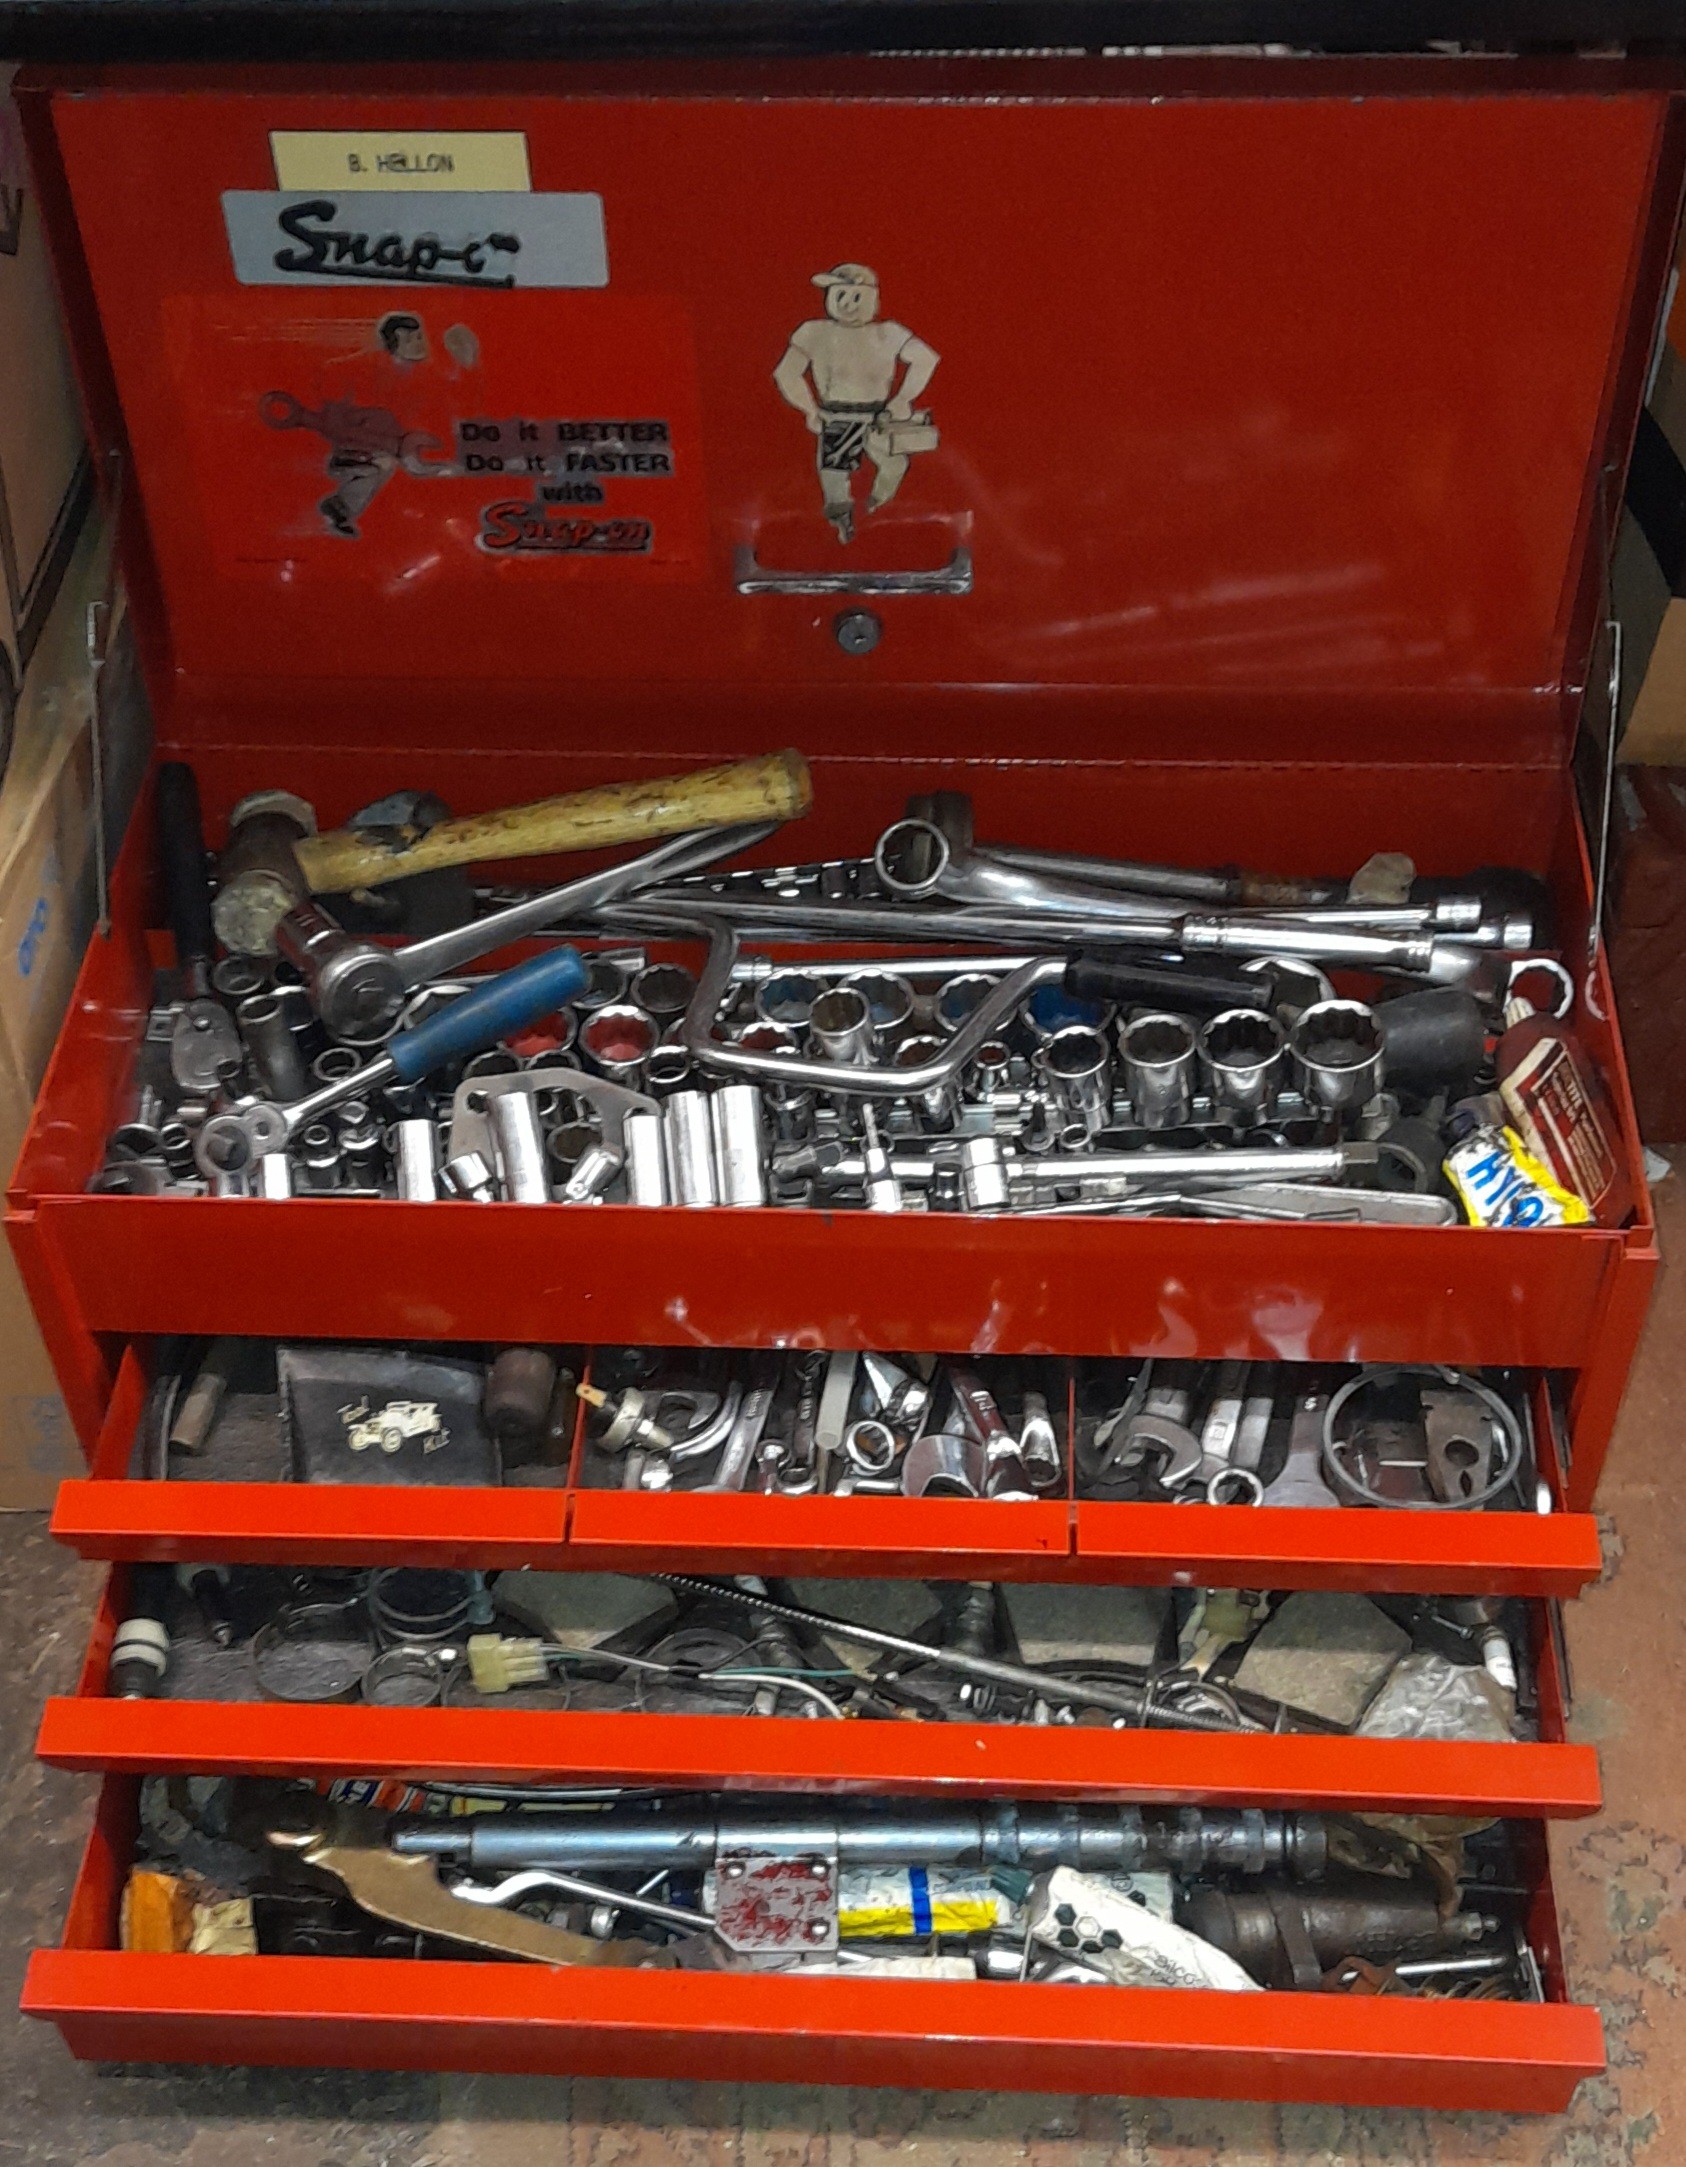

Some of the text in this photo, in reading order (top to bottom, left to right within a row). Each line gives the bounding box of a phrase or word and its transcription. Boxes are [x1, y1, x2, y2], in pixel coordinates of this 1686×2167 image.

[461, 422, 501, 441] Do
[557, 422, 668, 441] BETTER
[466, 453, 504, 472] Do
[566, 452, 671, 473] FASTER
[541, 481, 603, 502] with
